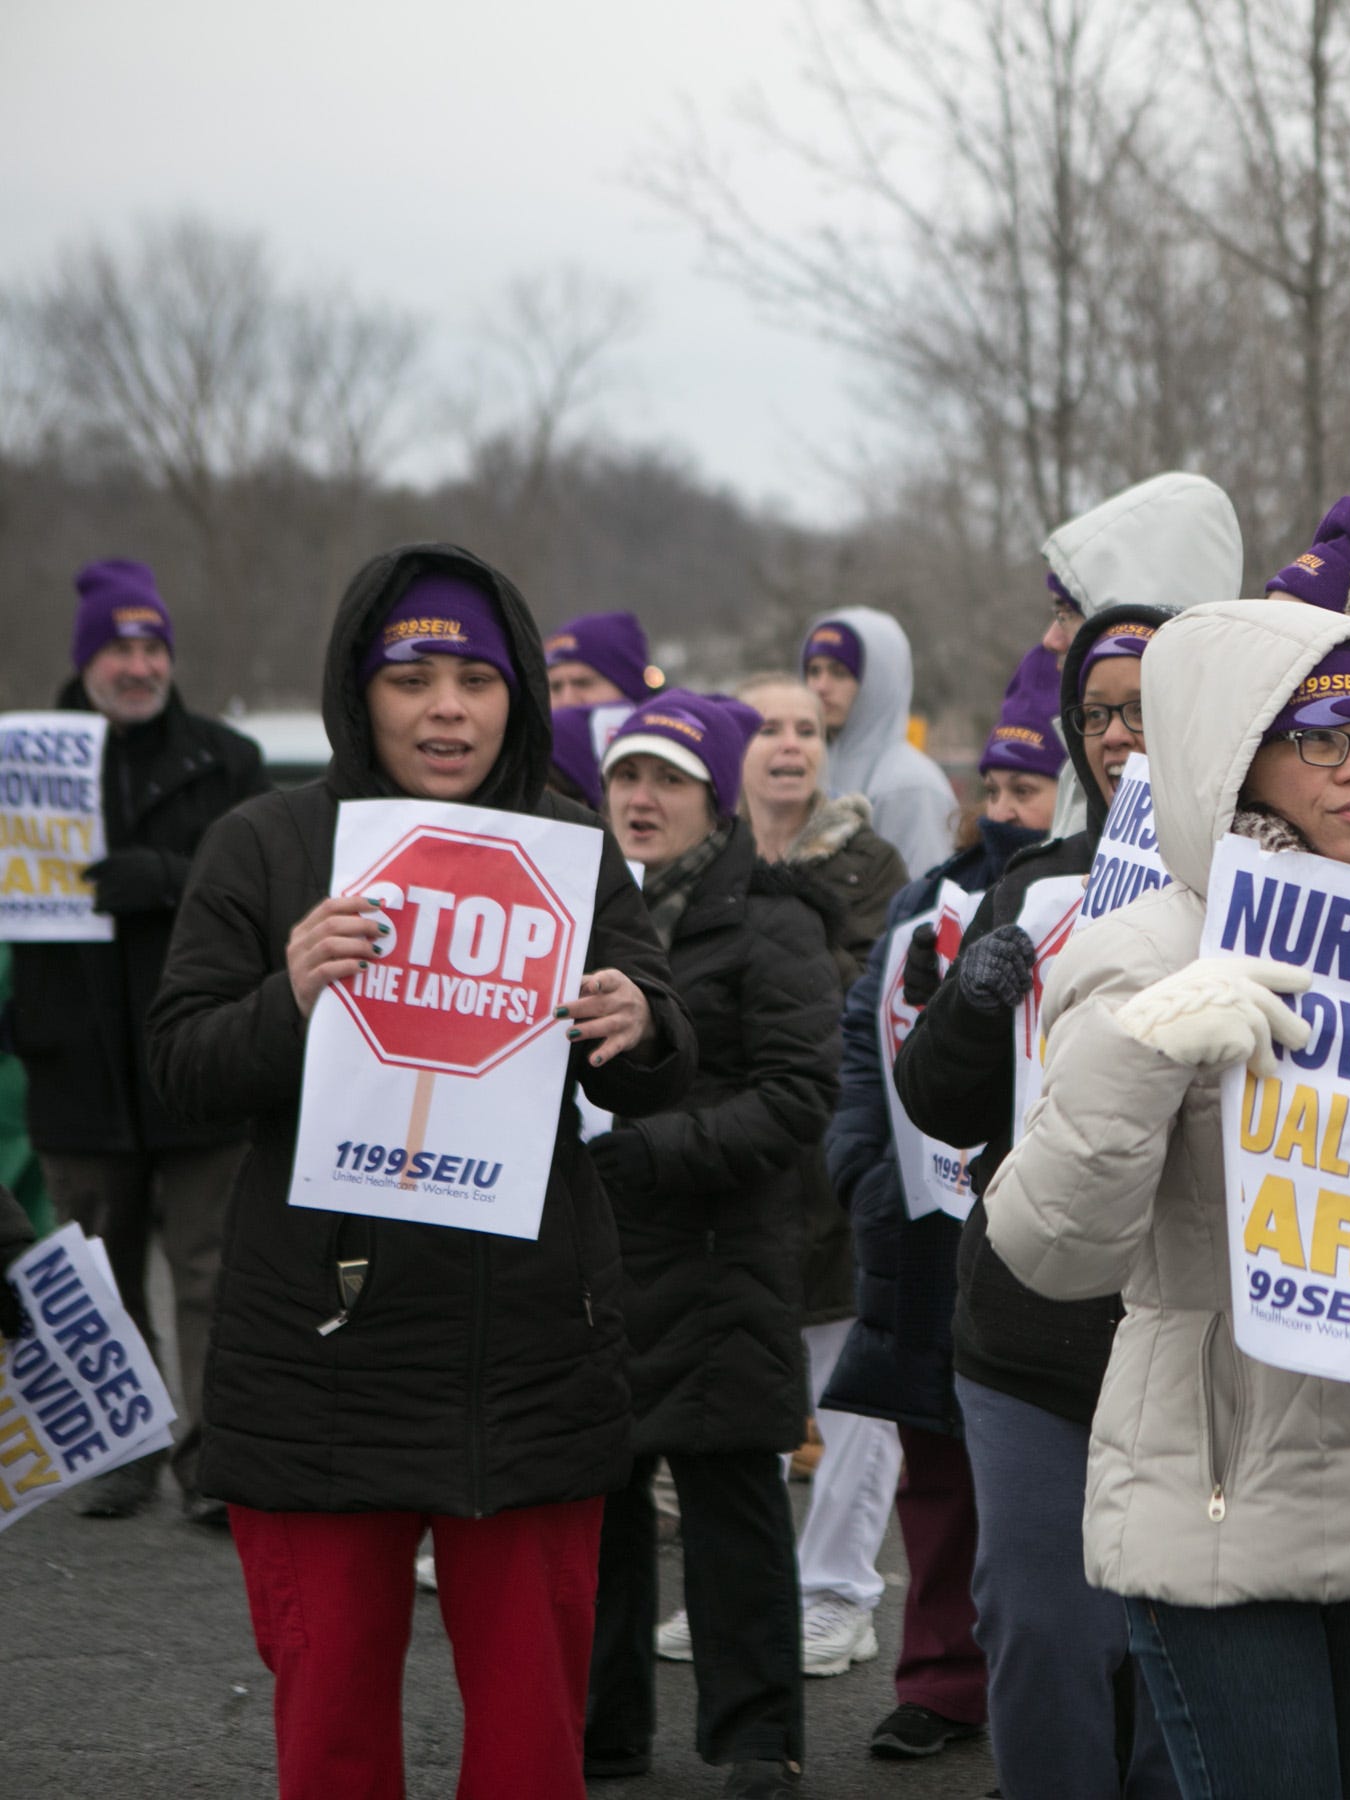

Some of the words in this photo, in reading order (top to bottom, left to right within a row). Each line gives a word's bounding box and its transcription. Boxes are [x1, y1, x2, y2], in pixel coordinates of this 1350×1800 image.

[353, 962, 404, 1004] THE
[404, 970, 538, 1025] LAYOFFS!
[332, 1170, 363, 1185] United
[366, 1174, 419, 1192] Healthcare
[423, 1181, 469, 1200] Workers
[472, 1189, 496, 1203] East
[336, 1141, 503, 1189] 1199SEIU
[24, 1245, 154, 1439] NURSES
[11, 1337, 110, 1474] OVIDE
